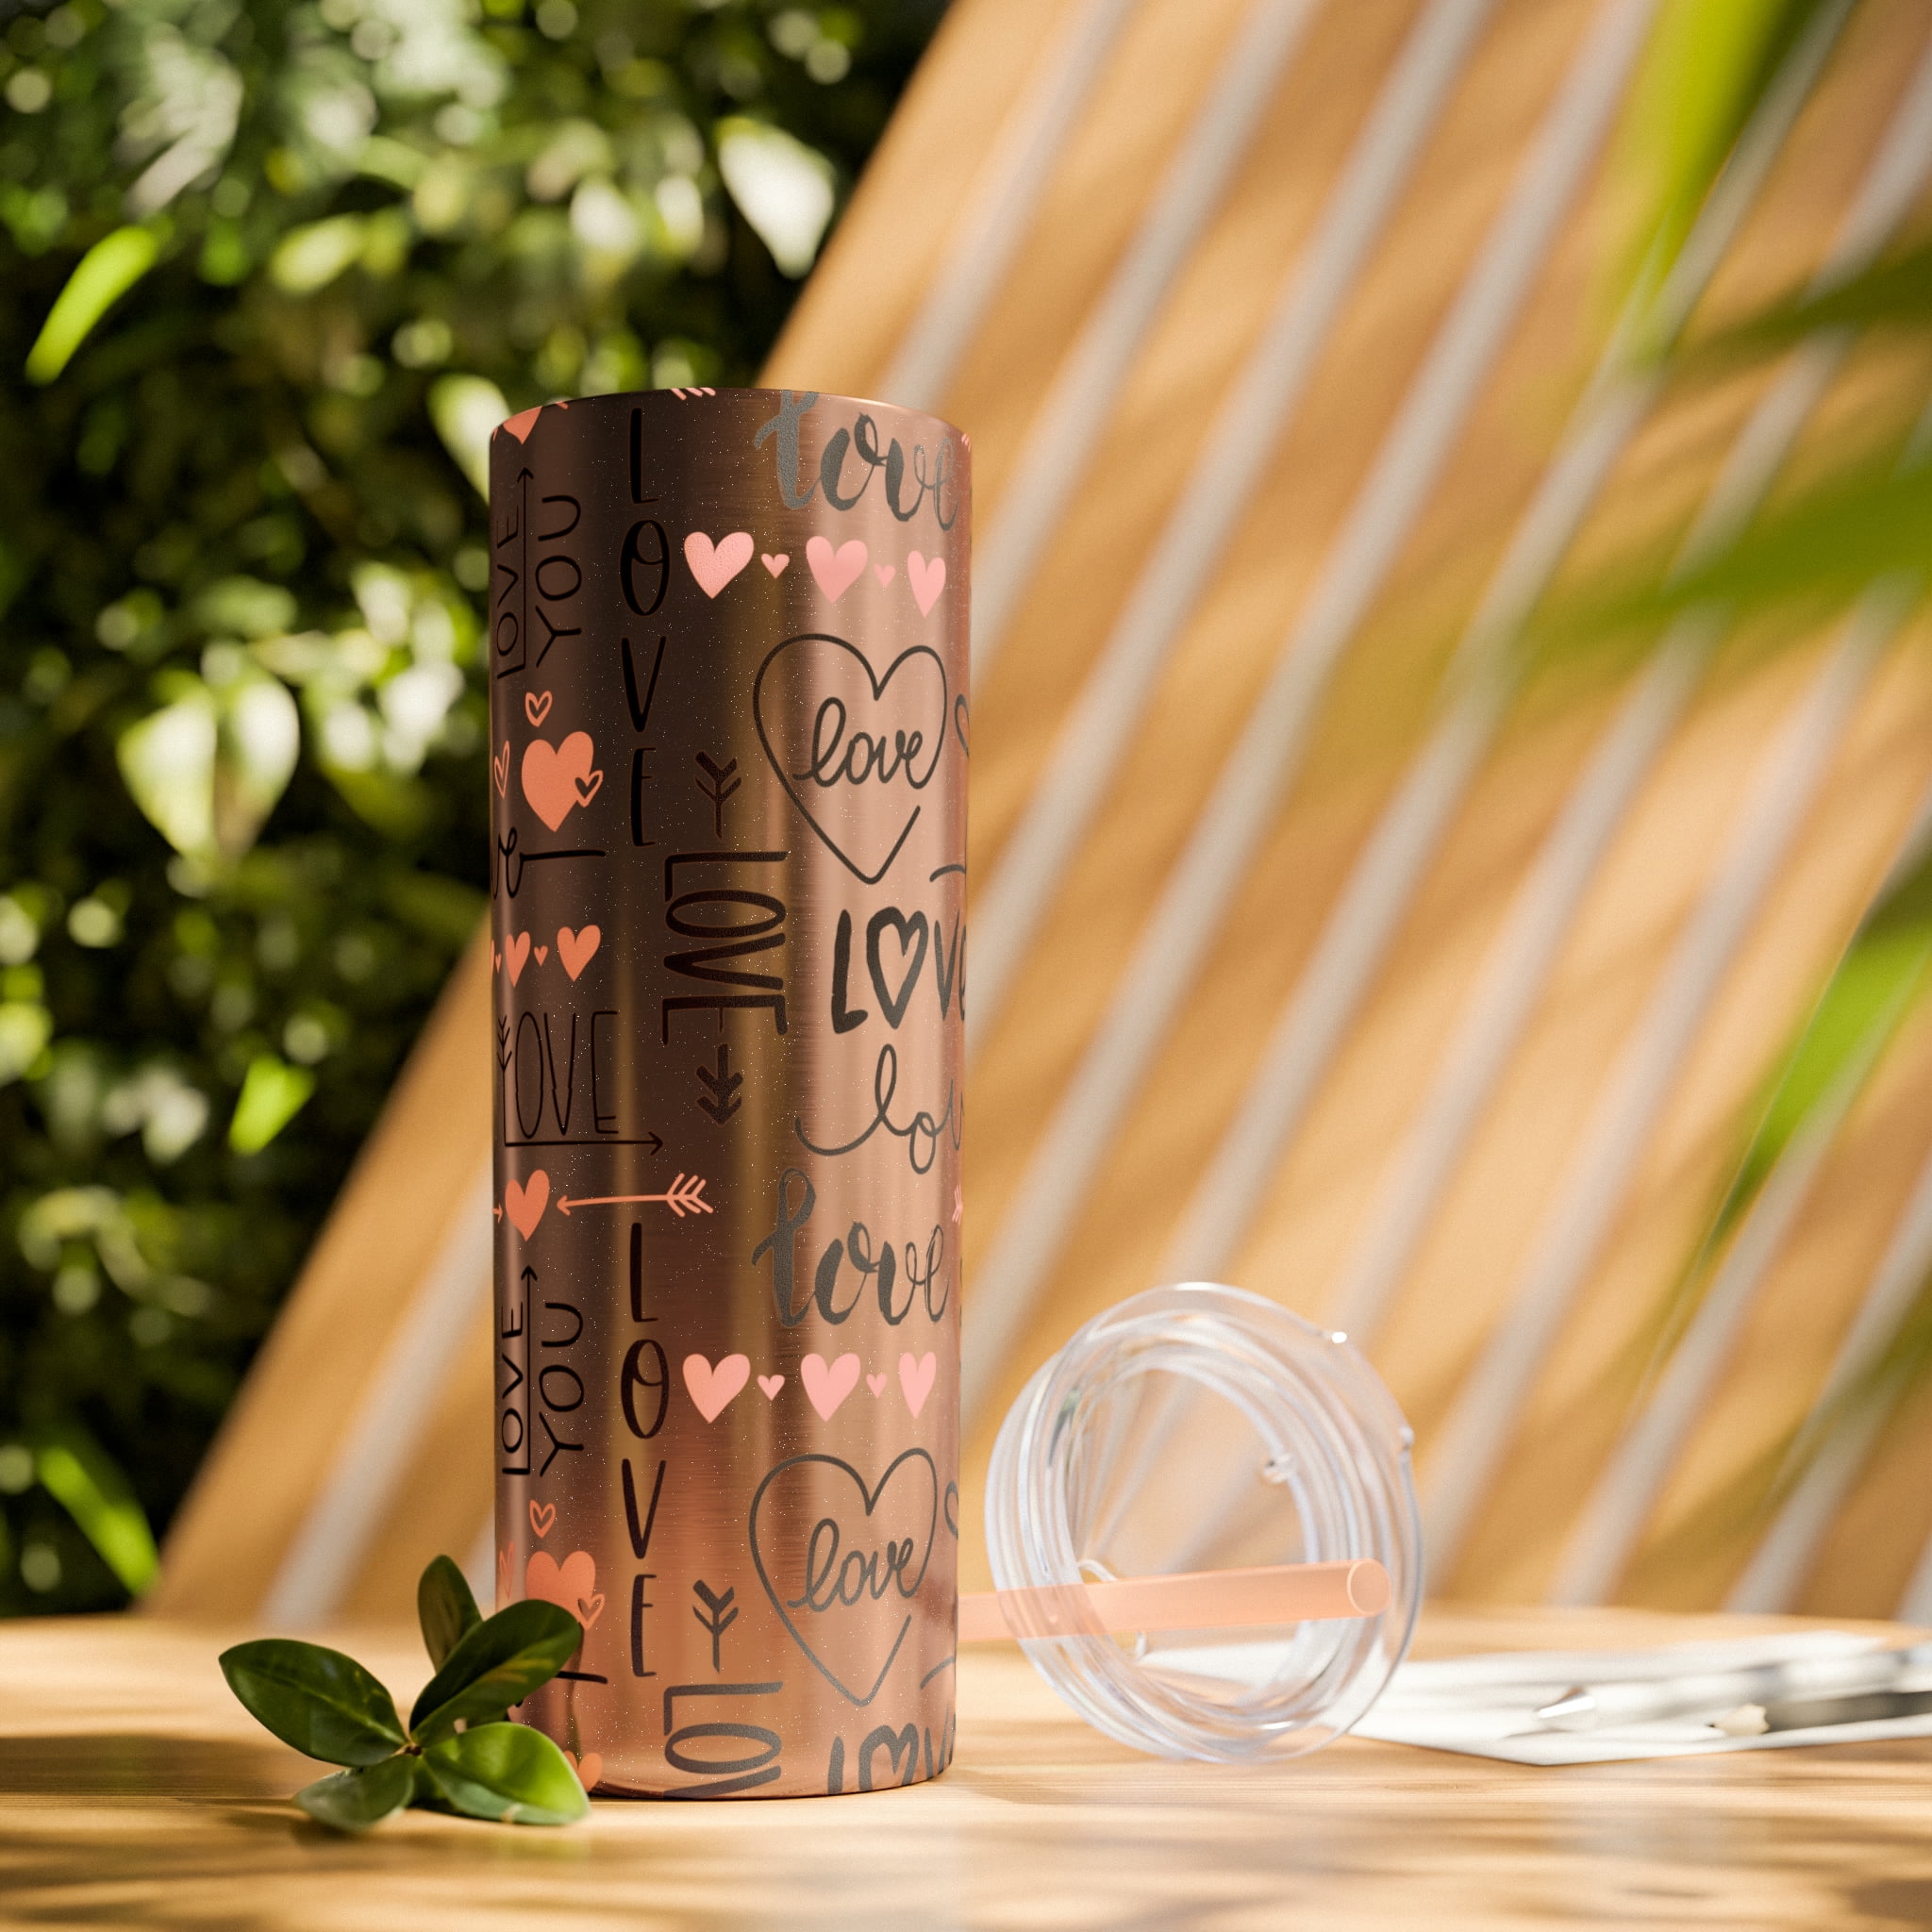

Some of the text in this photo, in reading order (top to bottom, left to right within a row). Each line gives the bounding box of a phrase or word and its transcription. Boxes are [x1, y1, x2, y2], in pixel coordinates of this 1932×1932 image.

[496, 505, 527, 679] LOVE
[535, 495, 582, 668] YOU
[619, 408, 671, 847] LOVE
[792, 696, 927, 790] love
[662, 851, 790, 1046] LOVE
[497, 1011, 620, 1147] LOVE
[751, 1168, 949, 1327] love
[502, 1301, 530, 1474] LOVE
[539, 1302, 584, 1477] YOU
[621, 1222, 670, 1677] LOVE
[786, 1518, 917, 1612] love
